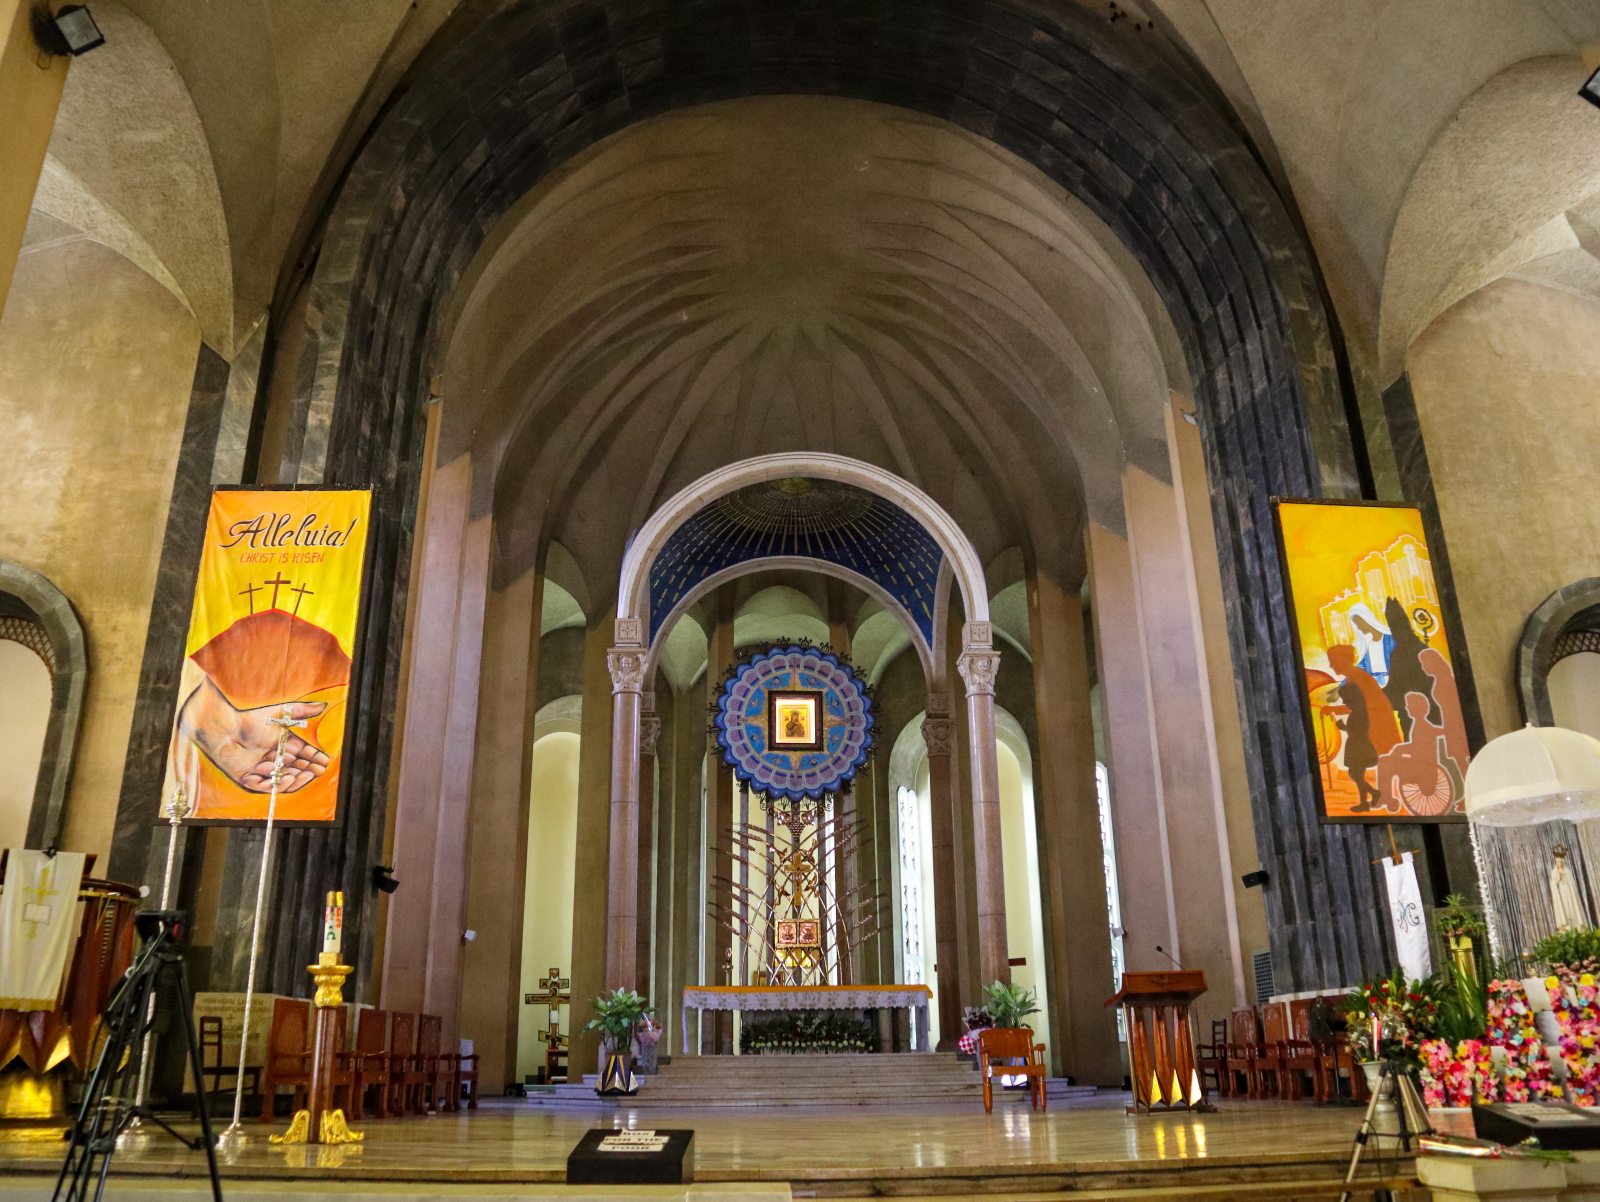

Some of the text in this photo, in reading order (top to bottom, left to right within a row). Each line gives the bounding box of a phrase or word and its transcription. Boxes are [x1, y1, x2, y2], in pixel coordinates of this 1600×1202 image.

[218, 512, 359, 549] Alleluia!
[240, 552, 325, 563] CHRIST IS RISEN
